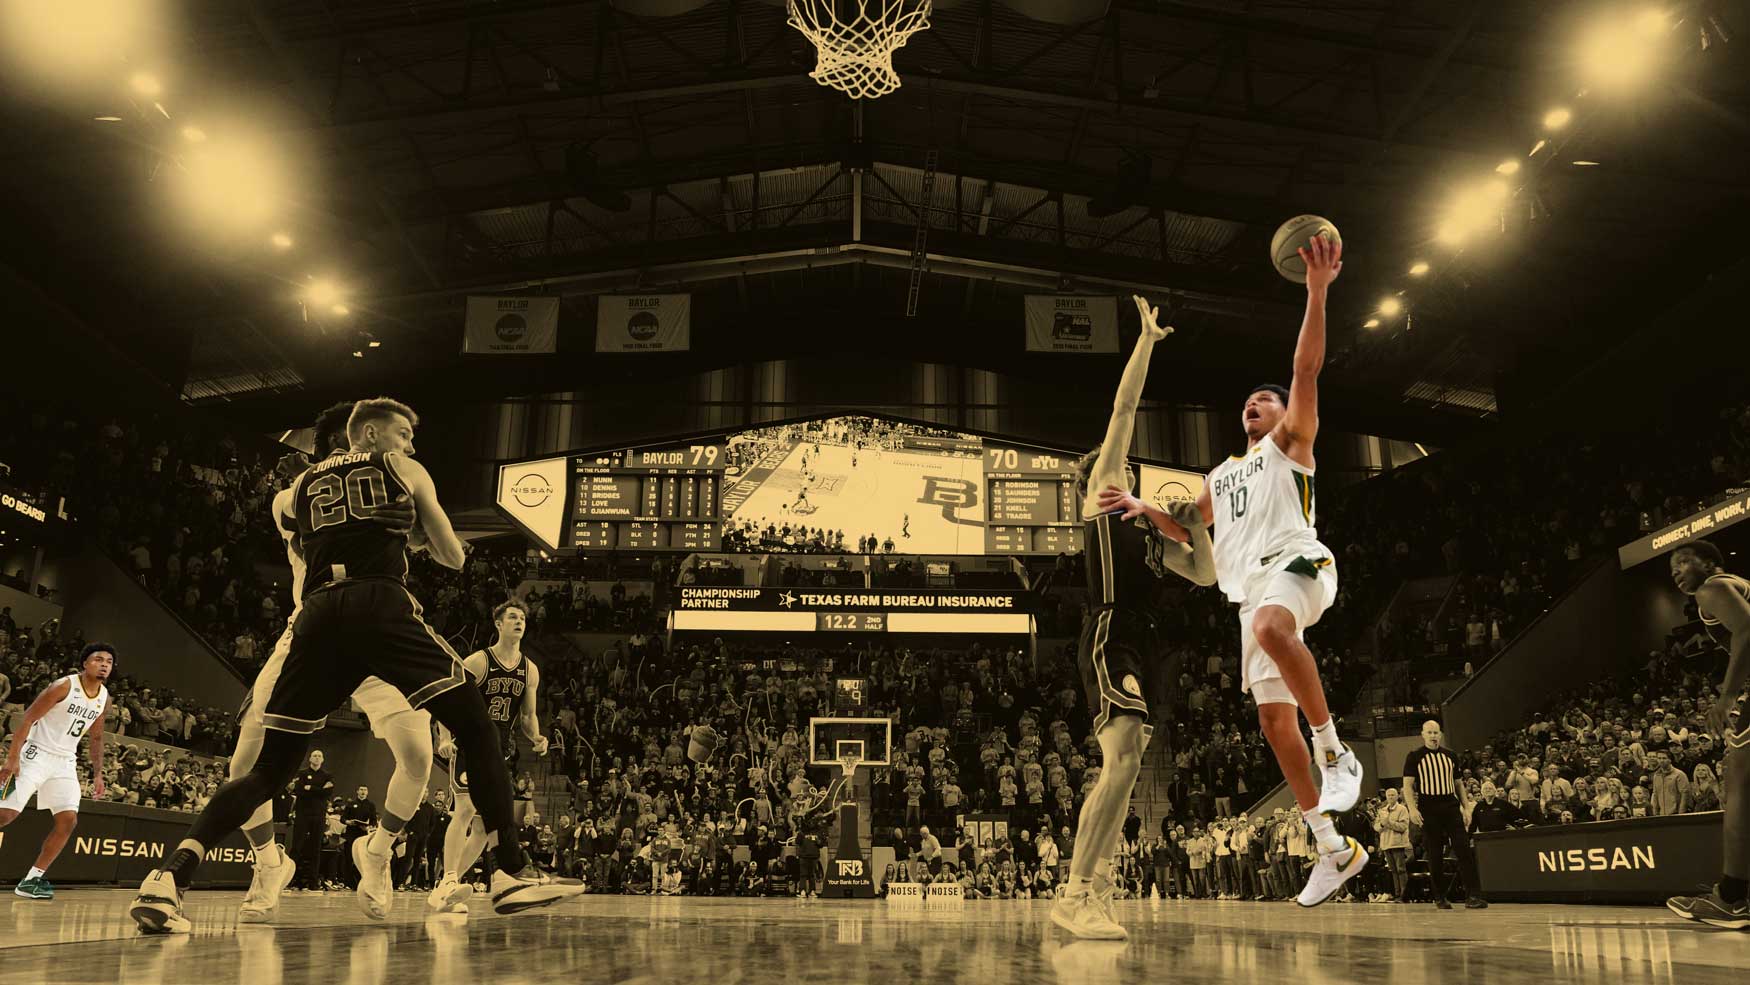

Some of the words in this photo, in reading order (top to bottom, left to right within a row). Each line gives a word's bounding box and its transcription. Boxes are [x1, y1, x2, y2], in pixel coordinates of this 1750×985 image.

[628, 298, 660, 307] BAYLOR
[1055, 298, 1087, 308] BAYLOR
[313, 452, 371, 474] JOHNSON
[643, 452, 684, 464] BAYLOR
[690, 446, 718, 465] 79
[990, 450, 1018, 469] 70
[1032, 456, 1059, 470] BYU
[1214, 456, 1265, 497] BAYLOR
[2, 494, 16, 508] GO
[16, 500, 46, 522] BEARS!
[306, 466, 389, 532] 20
[1229, 485, 1249, 522] 10
[1652, 525, 1691, 550] CONNECT,
[1691, 515, 1715, 534] DINE,
[1714, 501, 1745, 523] WORK,
[681, 588, 761, 600] CHAMPIONSHIP
[681, 598, 730, 609] PARTNER
[800, 594, 842, 606] TEXAS
[844, 594, 880, 607] FARM
[882, 595, 935, 608] BUREAU
[937, 596, 1013, 608] INSURANCE
[824, 615, 857, 629] 12.2
[866, 616, 882, 624] 2ND
[486, 678, 525, 696] BYU
[488, 696, 512, 722] 21
[66, 718, 86, 738] 13
[74, 836, 165, 858] NISSAN
[205, 847, 255, 863] NISSA
[1538, 845, 1656, 872] NISSAN
[890, 886, 918, 896] NOISE
[932, 887, 959, 896] NOISE
